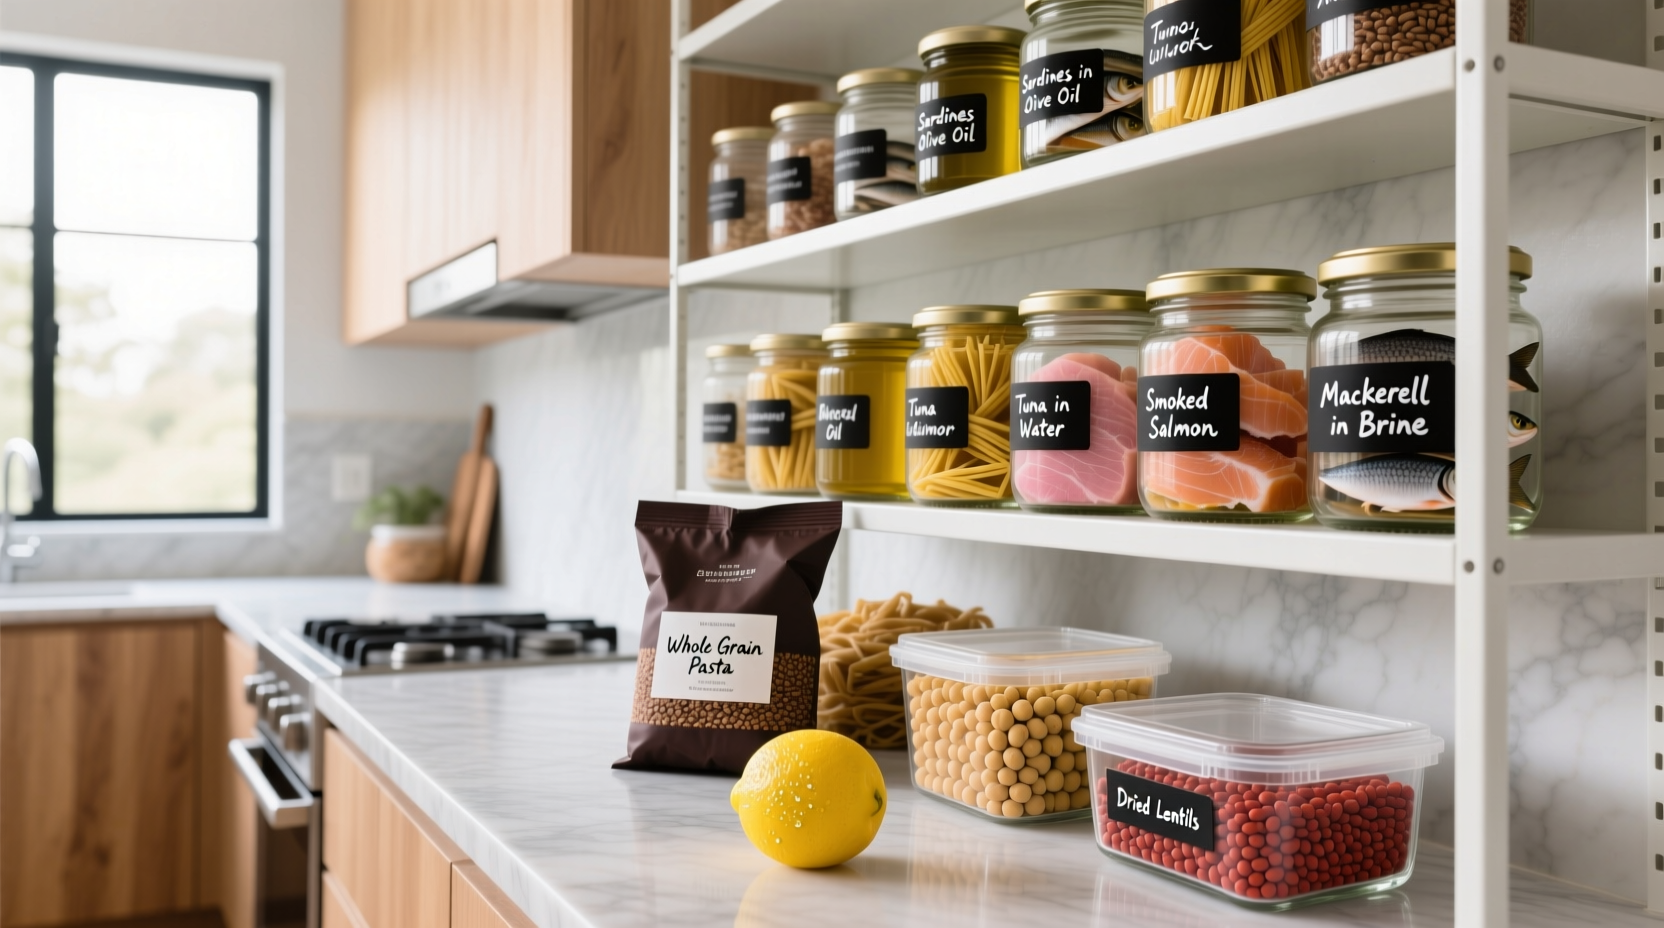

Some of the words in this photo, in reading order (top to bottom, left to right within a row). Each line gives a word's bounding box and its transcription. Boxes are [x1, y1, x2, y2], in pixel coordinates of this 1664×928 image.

[1022, 67, 1073, 94] Sardines
[1079, 64, 1093, 79] in
[1057, 83, 1080, 105] Oil
[918, 106, 975, 131] Sardines
[952, 122, 976, 143] Oil
[1015, 393, 1047, 414] Tuna
[1054, 395, 1070, 413] in
[1146, 385, 1209, 412] Smoked
[1320, 374, 1430, 409] Mackerell
[908, 397, 937, 417] Tuna
[1019, 418, 1065, 439] Water
[1149, 414, 1218, 440] Salmon
[1330, 415, 1348, 436] in
[1358, 410, 1429, 438] Brine
[667, 633, 712, 654] Whole
[717, 635, 763, 656] Grain
[688, 656, 734, 675] Pasta
[1117, 786, 1151, 815] Dried
[1156, 799, 1200, 831] Lentils
